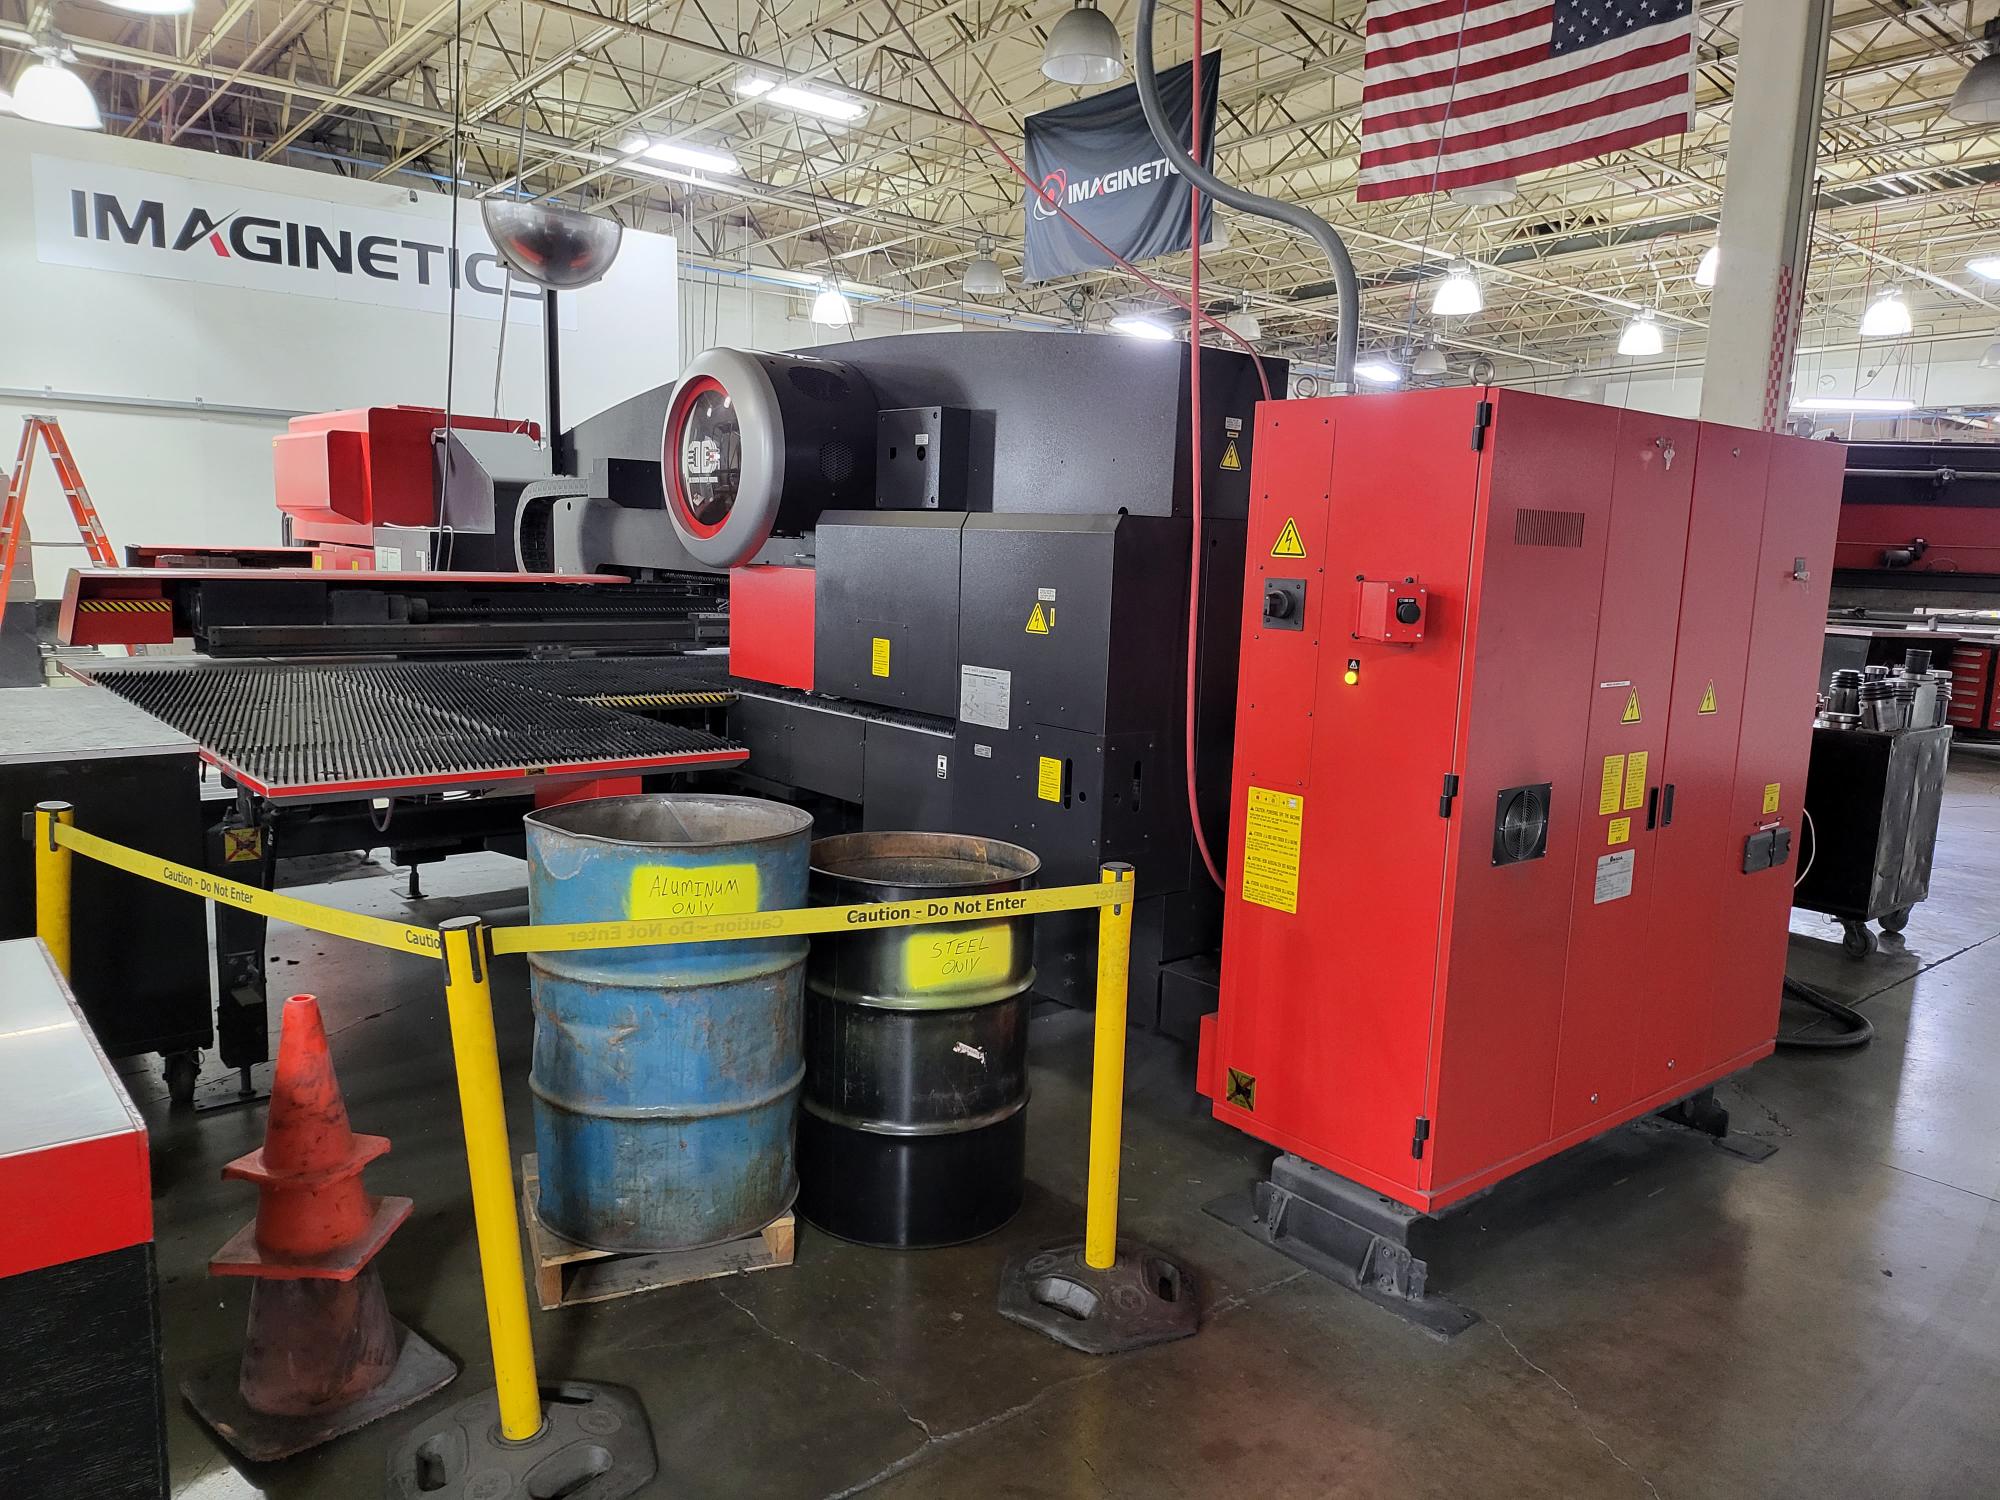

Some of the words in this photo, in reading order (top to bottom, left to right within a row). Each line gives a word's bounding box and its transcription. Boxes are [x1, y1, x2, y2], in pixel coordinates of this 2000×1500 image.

[1068, 151, 1193, 204] IMAGINETI
[163, 867, 193, 887] Caution
[200, 878, 212, 892] Do
[213, 882, 228, 897] Not
[230, 887, 253, 904] Enter
[649, 875, 740, 897] ALUMINUM
[847, 907, 910, 923] Caution
[927, 904, 949, 917] Do
[954, 900, 981, 915] Not
[986, 897, 1027, 912] Enter
[405, 929, 441, 949] Cautio
[930, 935, 990, 959] STEEL
